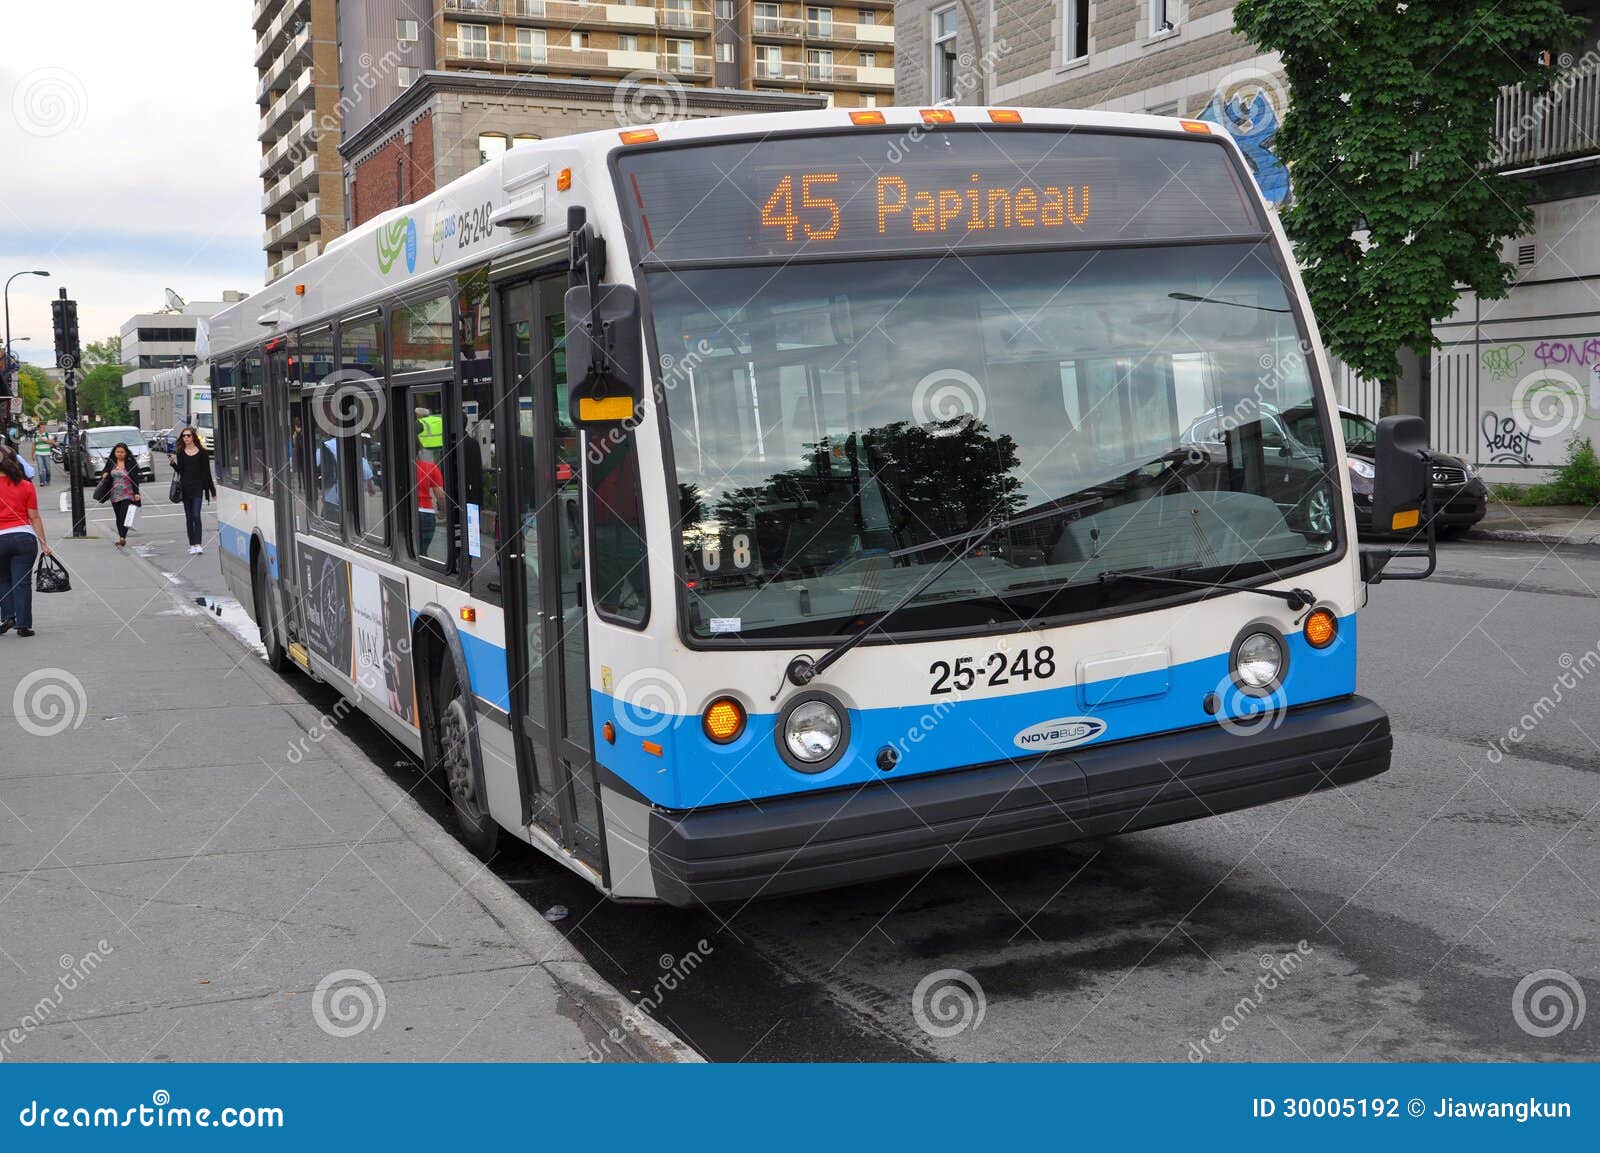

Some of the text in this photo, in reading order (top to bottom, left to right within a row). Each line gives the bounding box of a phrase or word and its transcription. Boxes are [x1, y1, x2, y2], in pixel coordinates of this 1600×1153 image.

[458, 201, 493, 248] 25-248
[762, 172, 1089, 240] 45 Papineau
[929, 646, 1056, 695] 25-248
